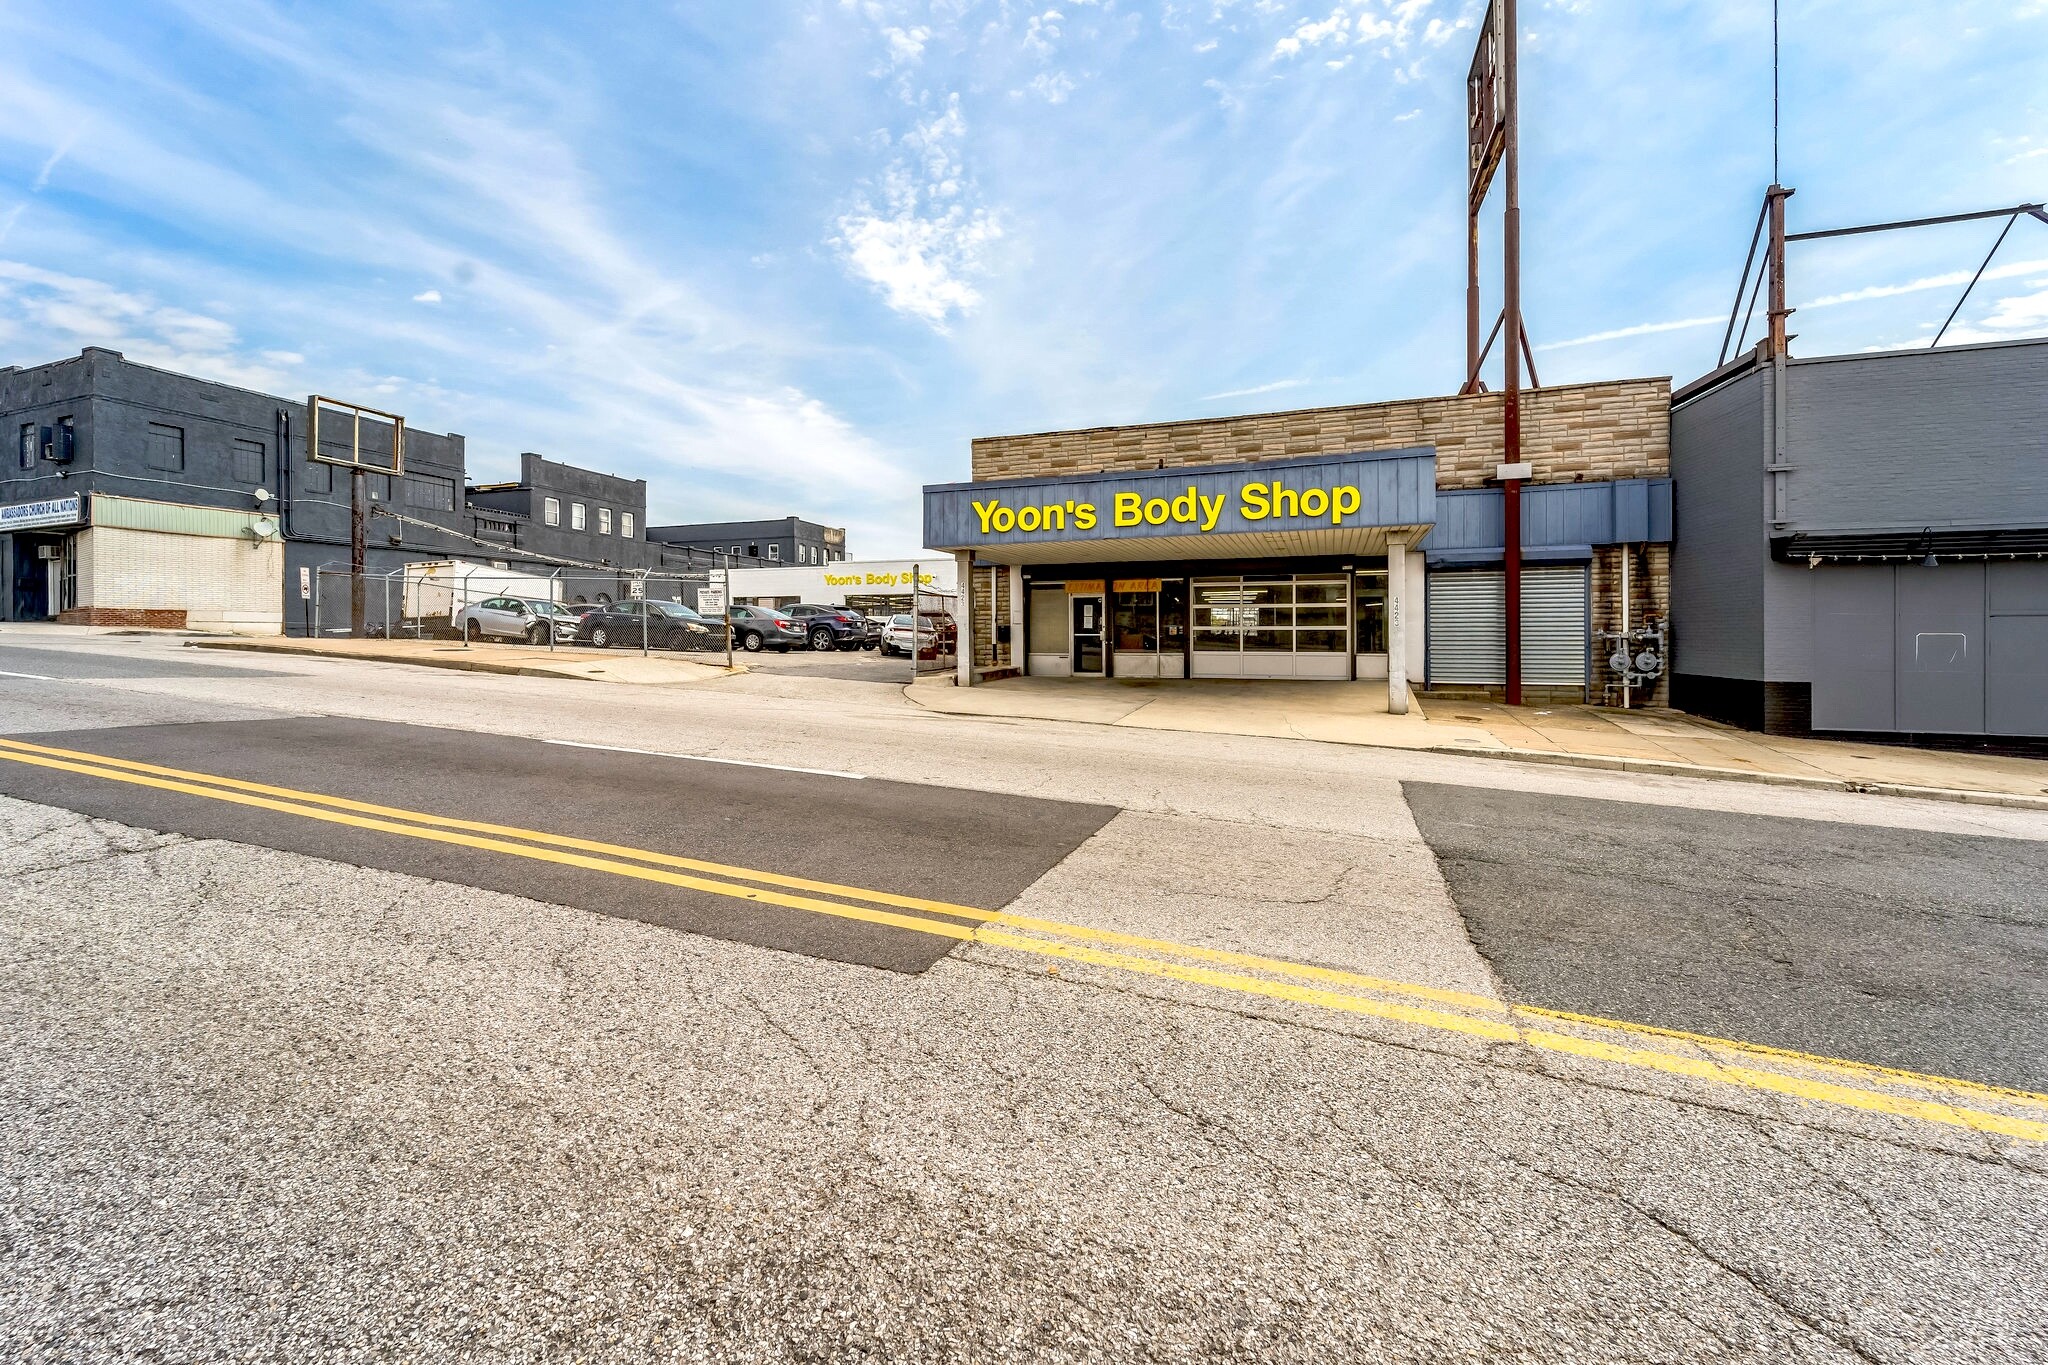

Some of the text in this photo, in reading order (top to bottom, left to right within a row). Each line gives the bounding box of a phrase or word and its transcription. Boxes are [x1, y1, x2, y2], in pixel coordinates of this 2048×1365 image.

[1, 506, 28, 519] AMBASSADORS
[29, 504, 45, 516] CHURCH
[45, 502, 51, 513] OF
[60, 499, 78, 512] NATIONS
[972, 481, 1361, 534] Yoon's Body Shop
[824, 574, 862, 586] Yoon's
[866, 572, 898, 587] Body
